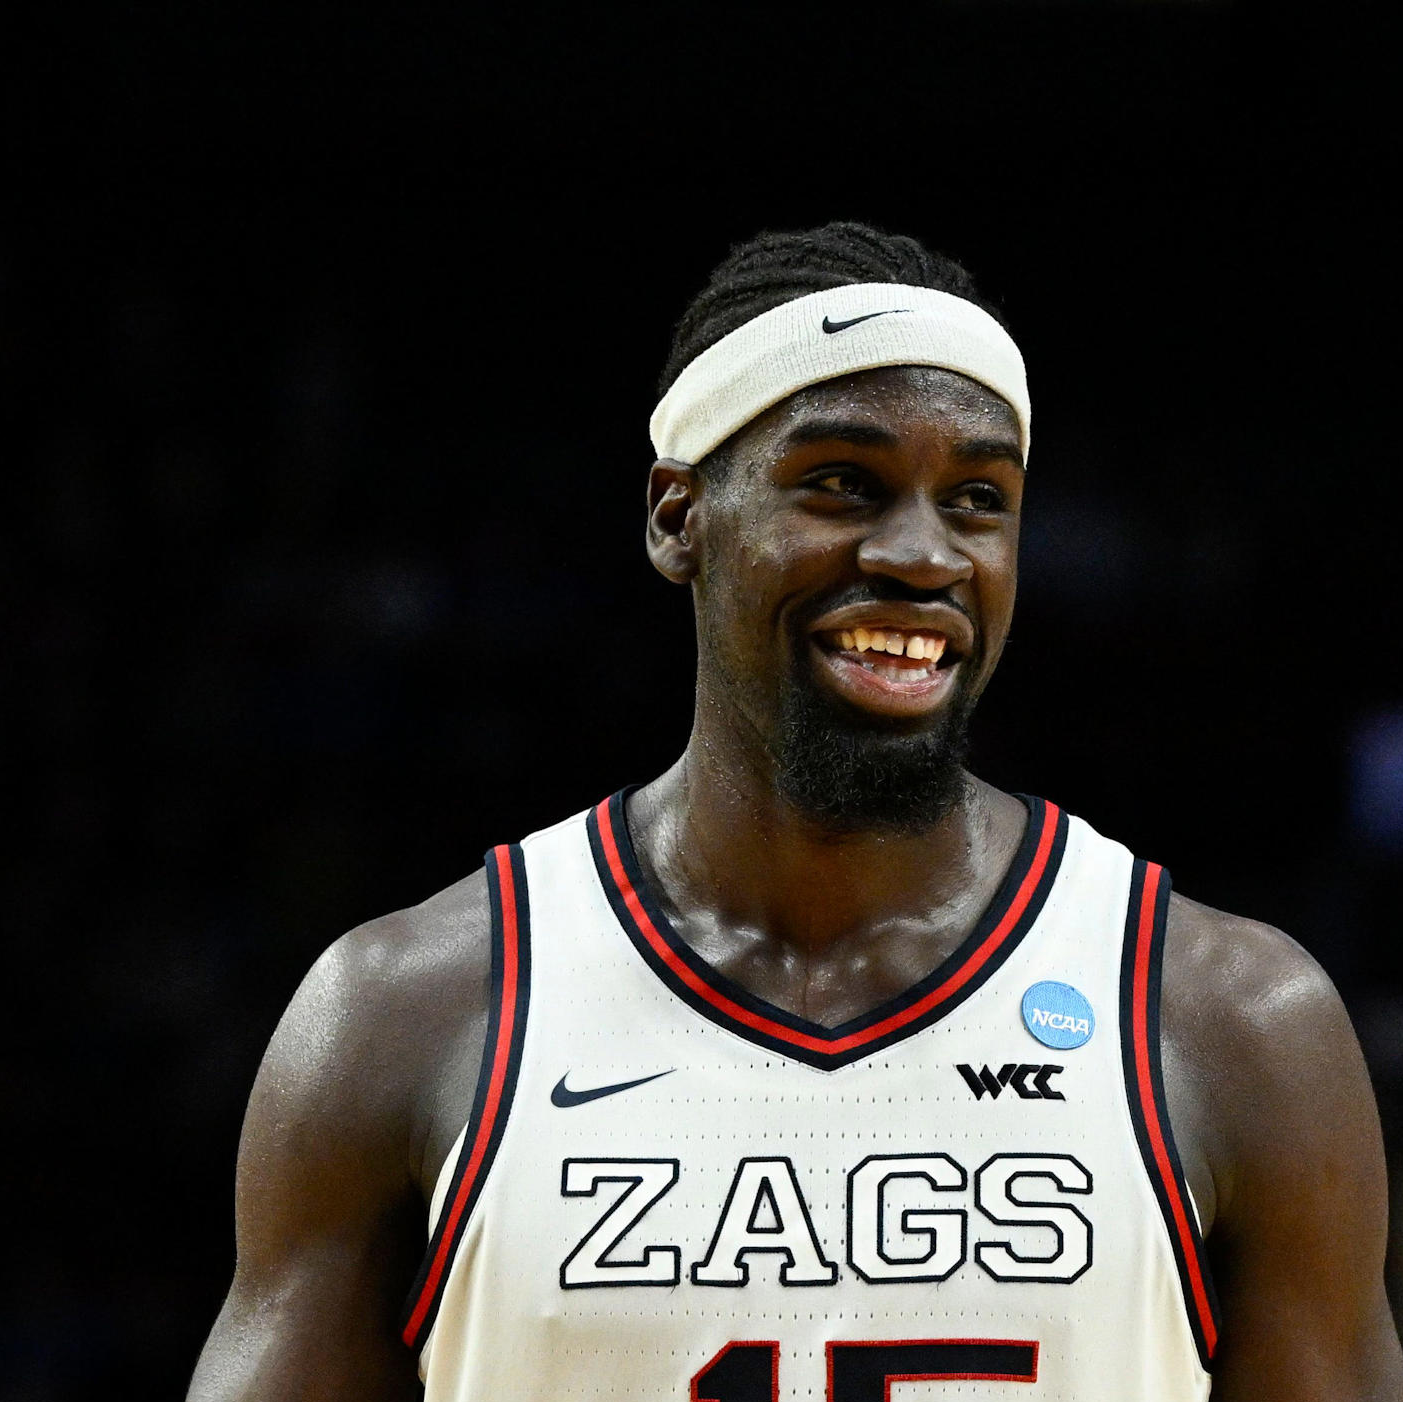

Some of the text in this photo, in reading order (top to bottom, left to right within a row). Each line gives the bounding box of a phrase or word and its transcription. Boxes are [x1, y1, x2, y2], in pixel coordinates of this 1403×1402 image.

[1031, 1008, 1090, 1035] NCAA
[956, 1063, 1066, 1101] WCC
[559, 1152, 1093, 1288] ZAGS
